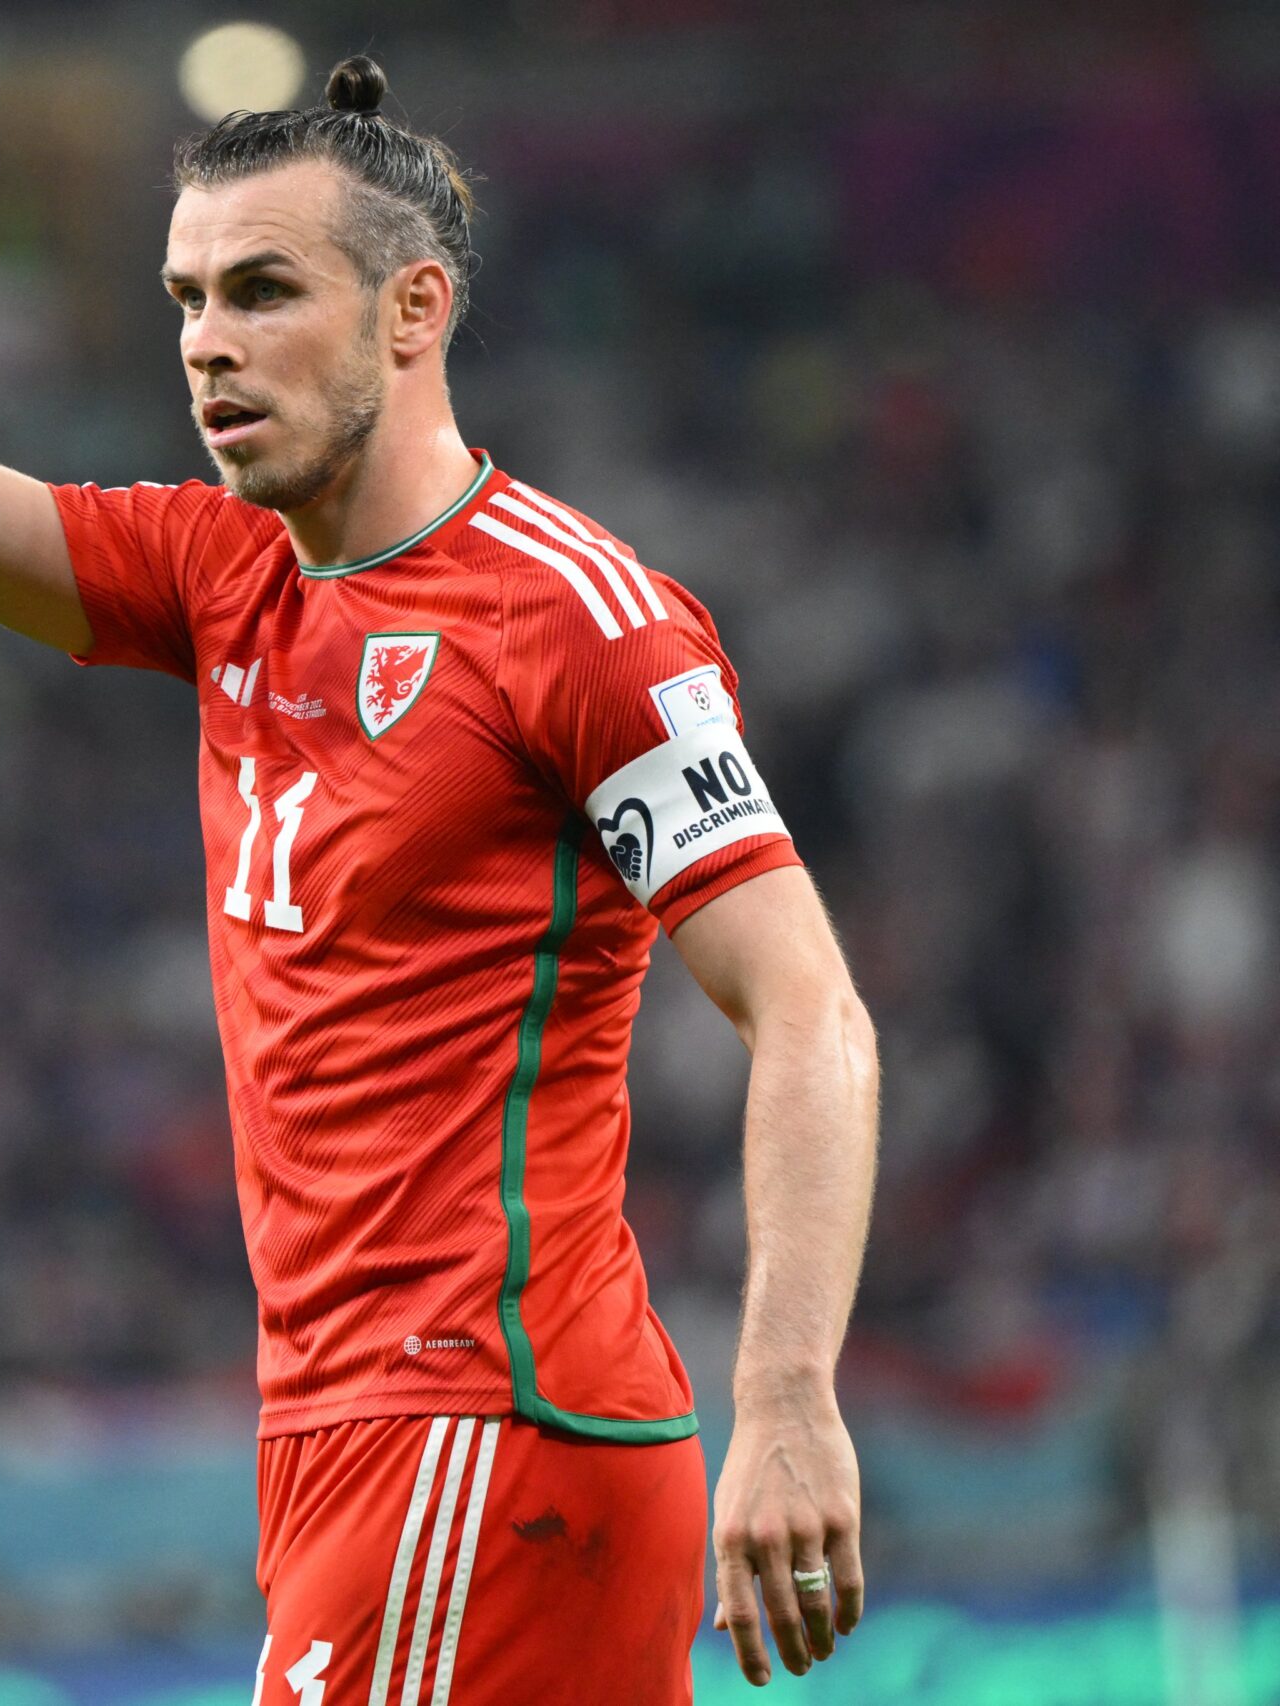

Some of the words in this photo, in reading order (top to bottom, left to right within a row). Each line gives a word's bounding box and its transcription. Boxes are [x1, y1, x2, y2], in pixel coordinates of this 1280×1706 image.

[274, 695, 310, 712] NOVEMBER
[276, 704, 294, 716] BIN
[292, 711, 306, 720] ALI
[682, 751, 752, 814] NO
[223, 756, 318, 933] 11
[425, 1339, 476, 1349] AEROREADY
